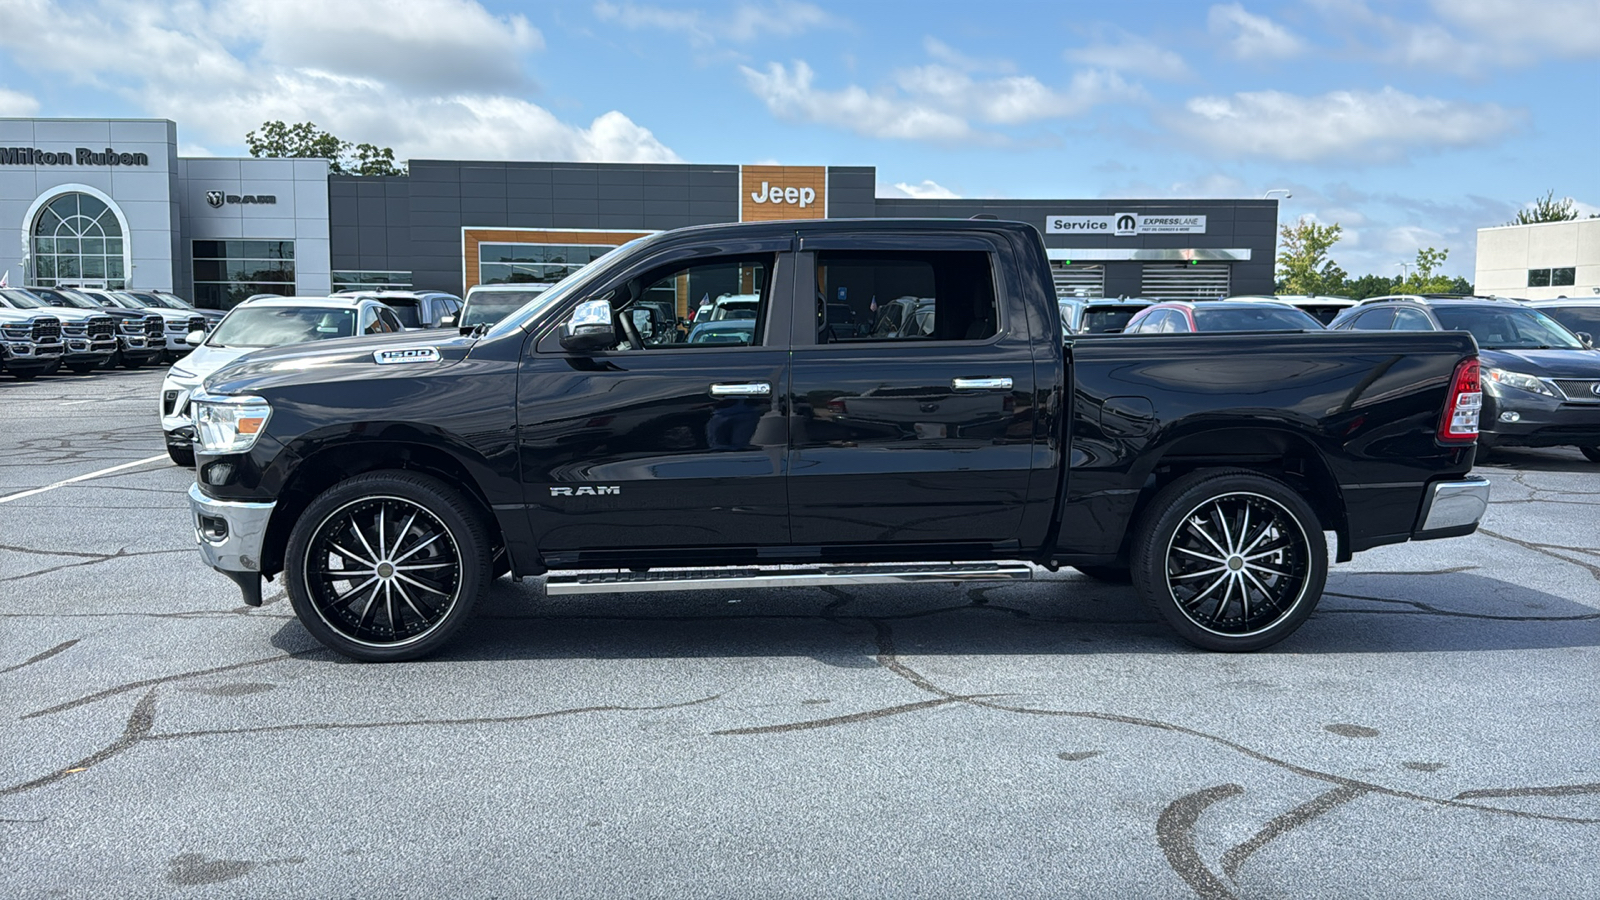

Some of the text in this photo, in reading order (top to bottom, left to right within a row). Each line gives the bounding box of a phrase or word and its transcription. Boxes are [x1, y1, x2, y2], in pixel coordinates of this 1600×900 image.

[0, 147, 148, 166] Milton Ruben
[226, 195, 277, 204] RAM
[751, 181, 816, 208] Jeep
[1053, 219, 1108, 230] Service
[383, 350, 430, 359] 1500
[549, 486, 620, 496] RAM
